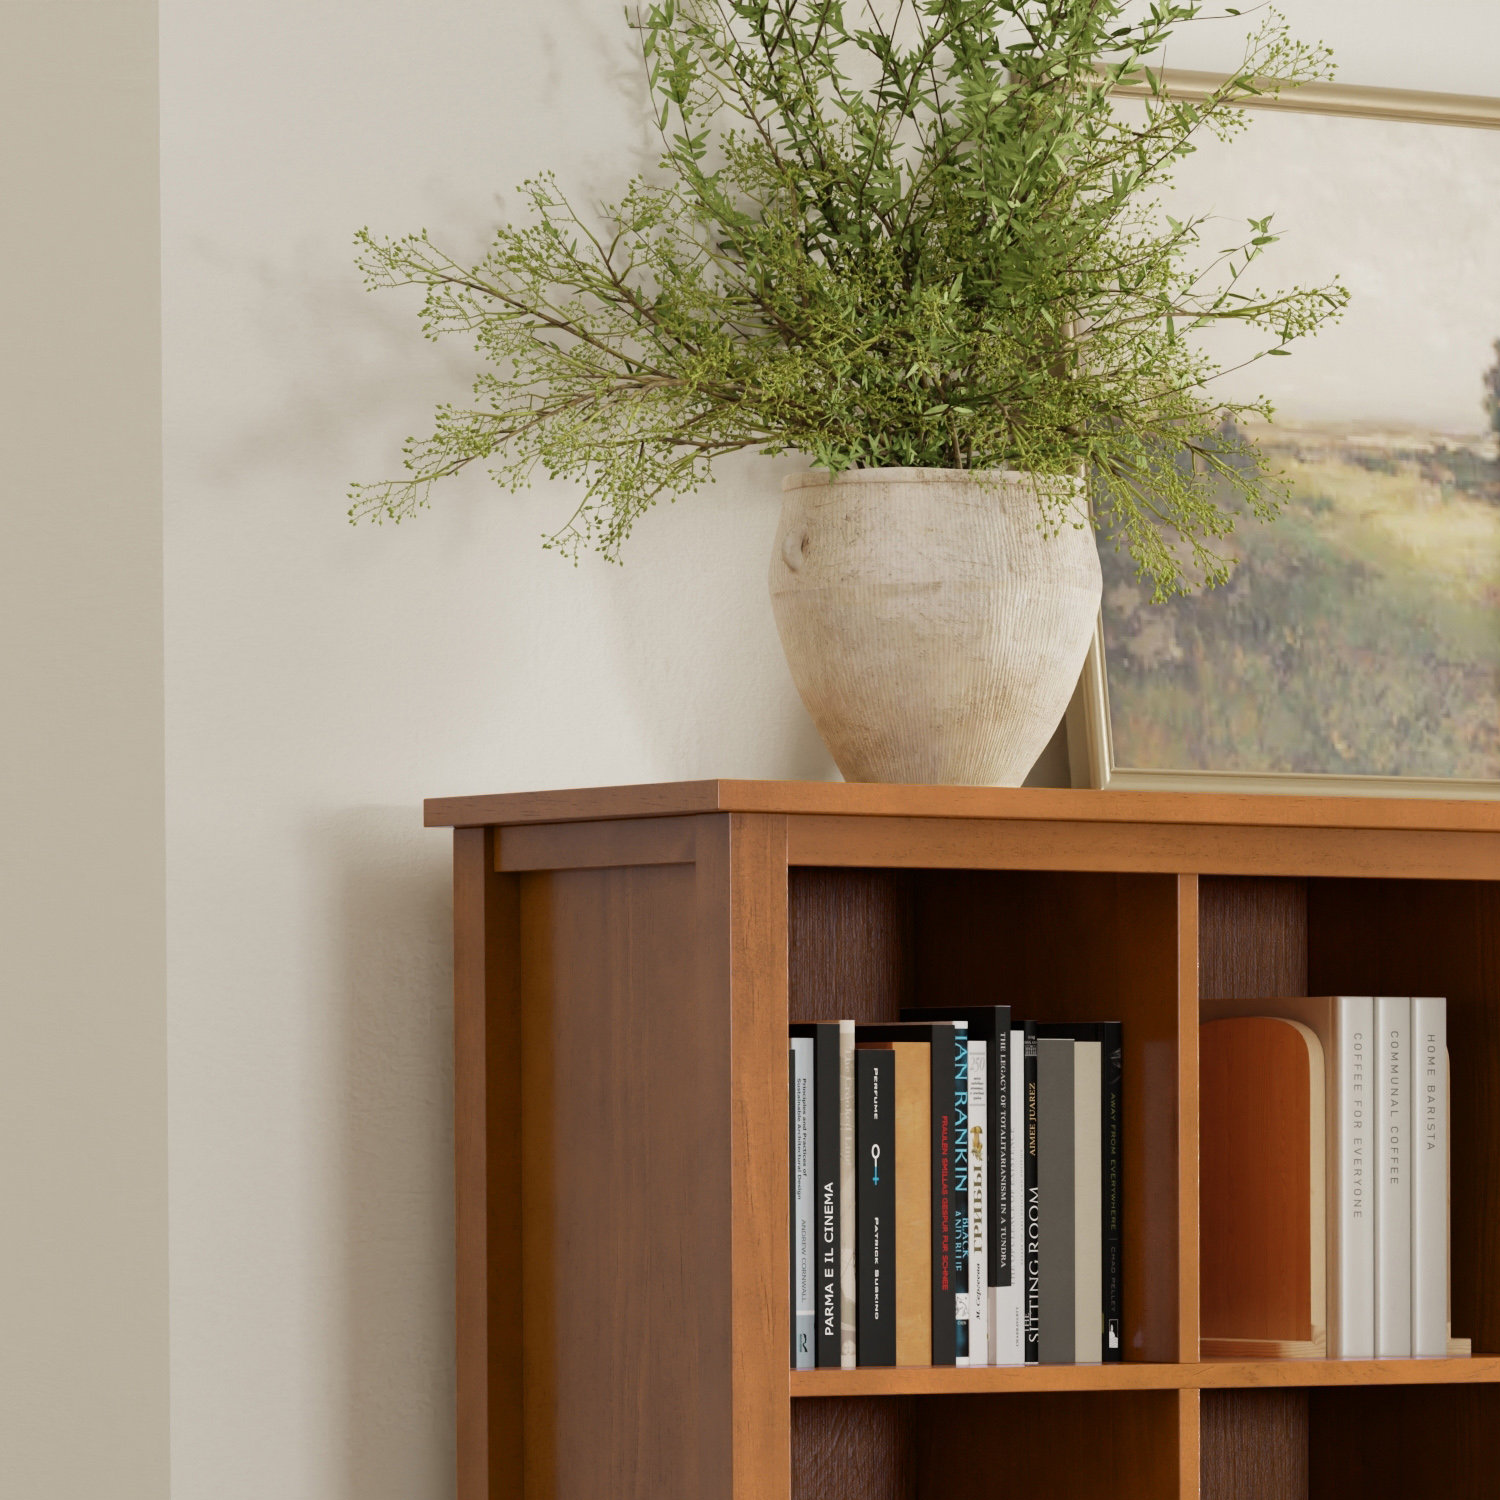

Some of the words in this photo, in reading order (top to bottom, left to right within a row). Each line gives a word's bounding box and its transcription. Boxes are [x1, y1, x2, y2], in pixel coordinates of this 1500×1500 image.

[954, 1035, 968, 1080] IAN
[1353, 1032, 1363, 1091] COFFEE
[1390, 1030, 1400, 1117] COMMUNAL
[1426, 1034, 1436, 1077] HOME
[1000, 1093, 1007, 1107] OF
[1353, 1101, 1363, 1129] FOR
[1426, 1085, 1436, 1151] BARISTA
[954, 1091, 968, 1192] RANKIN
[1390, 1126, 1400, 1185] COFFEE
[1353, 1138, 1363, 1219] EVERYONE
[823, 1182, 834, 1243] CINEMA
[973, 1165, 983, 1253] ГРИБЫ
[1000, 1203, 1007, 1214] IN
[1028, 1187, 1039, 1253] ROOM
[824, 1247, 834, 1263] IL
[824, 1268, 834, 1278] E
[824, 1282, 834, 1336] PARMA
[1029, 1260, 1039, 1343] SITTING
